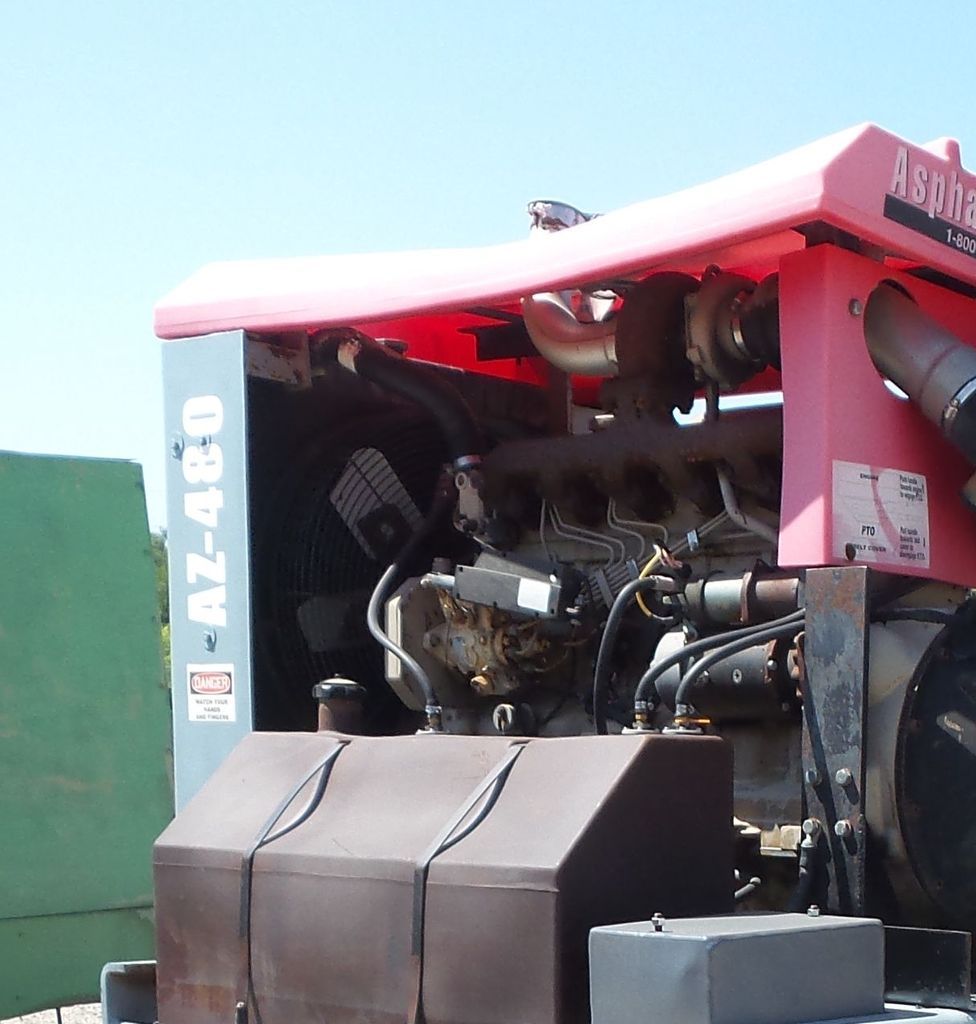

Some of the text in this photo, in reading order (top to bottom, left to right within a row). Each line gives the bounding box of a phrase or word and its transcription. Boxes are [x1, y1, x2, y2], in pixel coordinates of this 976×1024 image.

[183, 395, 227, 628] AZ-480
[861, 525, 876, 537] PTO
[192, 676, 230, 690] DANGER
